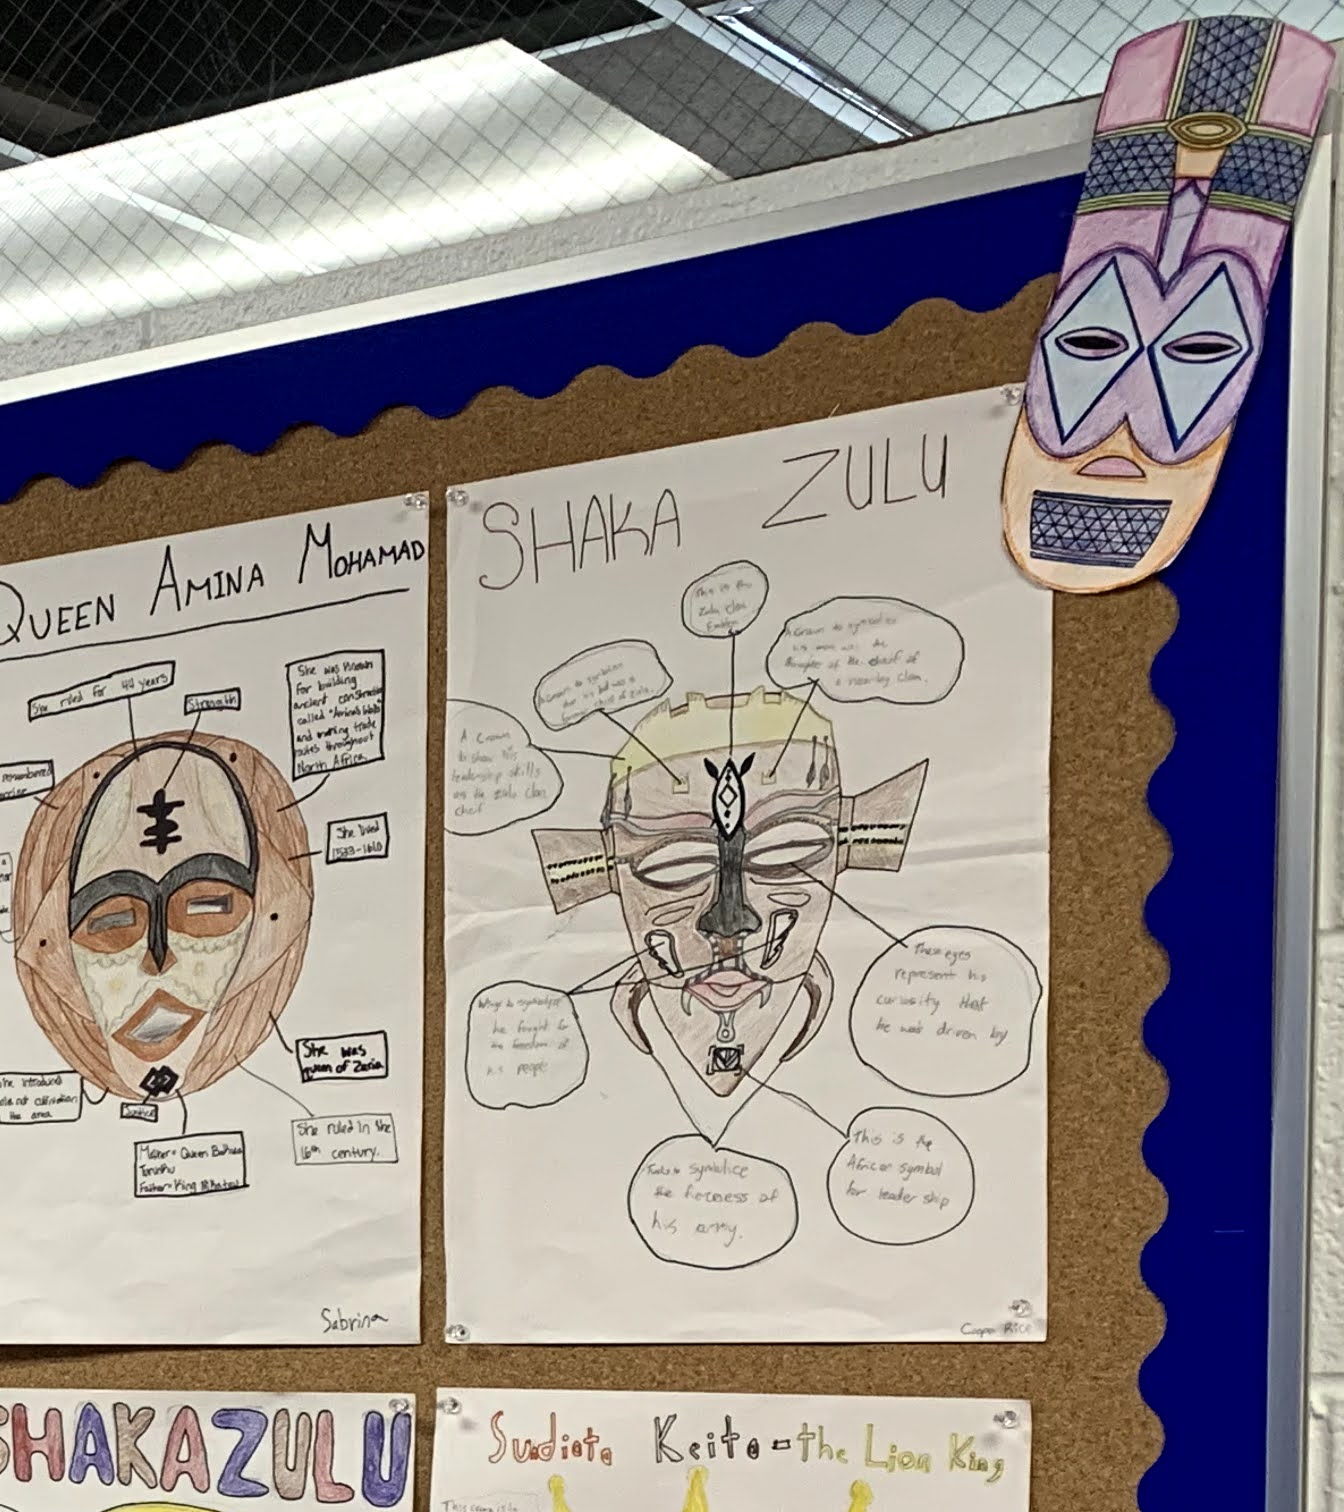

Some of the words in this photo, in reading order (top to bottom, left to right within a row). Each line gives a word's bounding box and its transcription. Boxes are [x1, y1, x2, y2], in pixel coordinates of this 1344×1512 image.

[479, 488, 682, 590] SHAKA
[762, 434, 948, 529] ZULU
[150, 545, 265, 617] AMINA
[297, 522, 426, 584] MOHAMAD
[298, 665, 317, 677] She
[324, 664, 340, 675] was
[138, 673, 168, 694] years
[318, 676, 357, 691] building
[297, 709, 325, 725] called
[297, 760, 327, 774] North
[944, 948, 971, 965] eyes
[302, 1040, 328, 1058] She
[341, 1045, 367, 1058] was
[302, 1062, 332, 1083] queen
[336, 1060, 350, 1073] of
[353, 1058, 384, 1073] Zaria
[31, 1110, 53, 1119] area
[297, 1123, 318, 1136] She
[327, 1120, 353, 1135] ruled
[358, 1121, 370, 1134] in
[853, 1130, 882, 1146] This
[899, 1161, 943, 1181] symbol
[321, 1308, 389, 1333] Sabrina
[864, 1423, 932, 1474] Lion
[948, 1433, 1005, 1485] King
